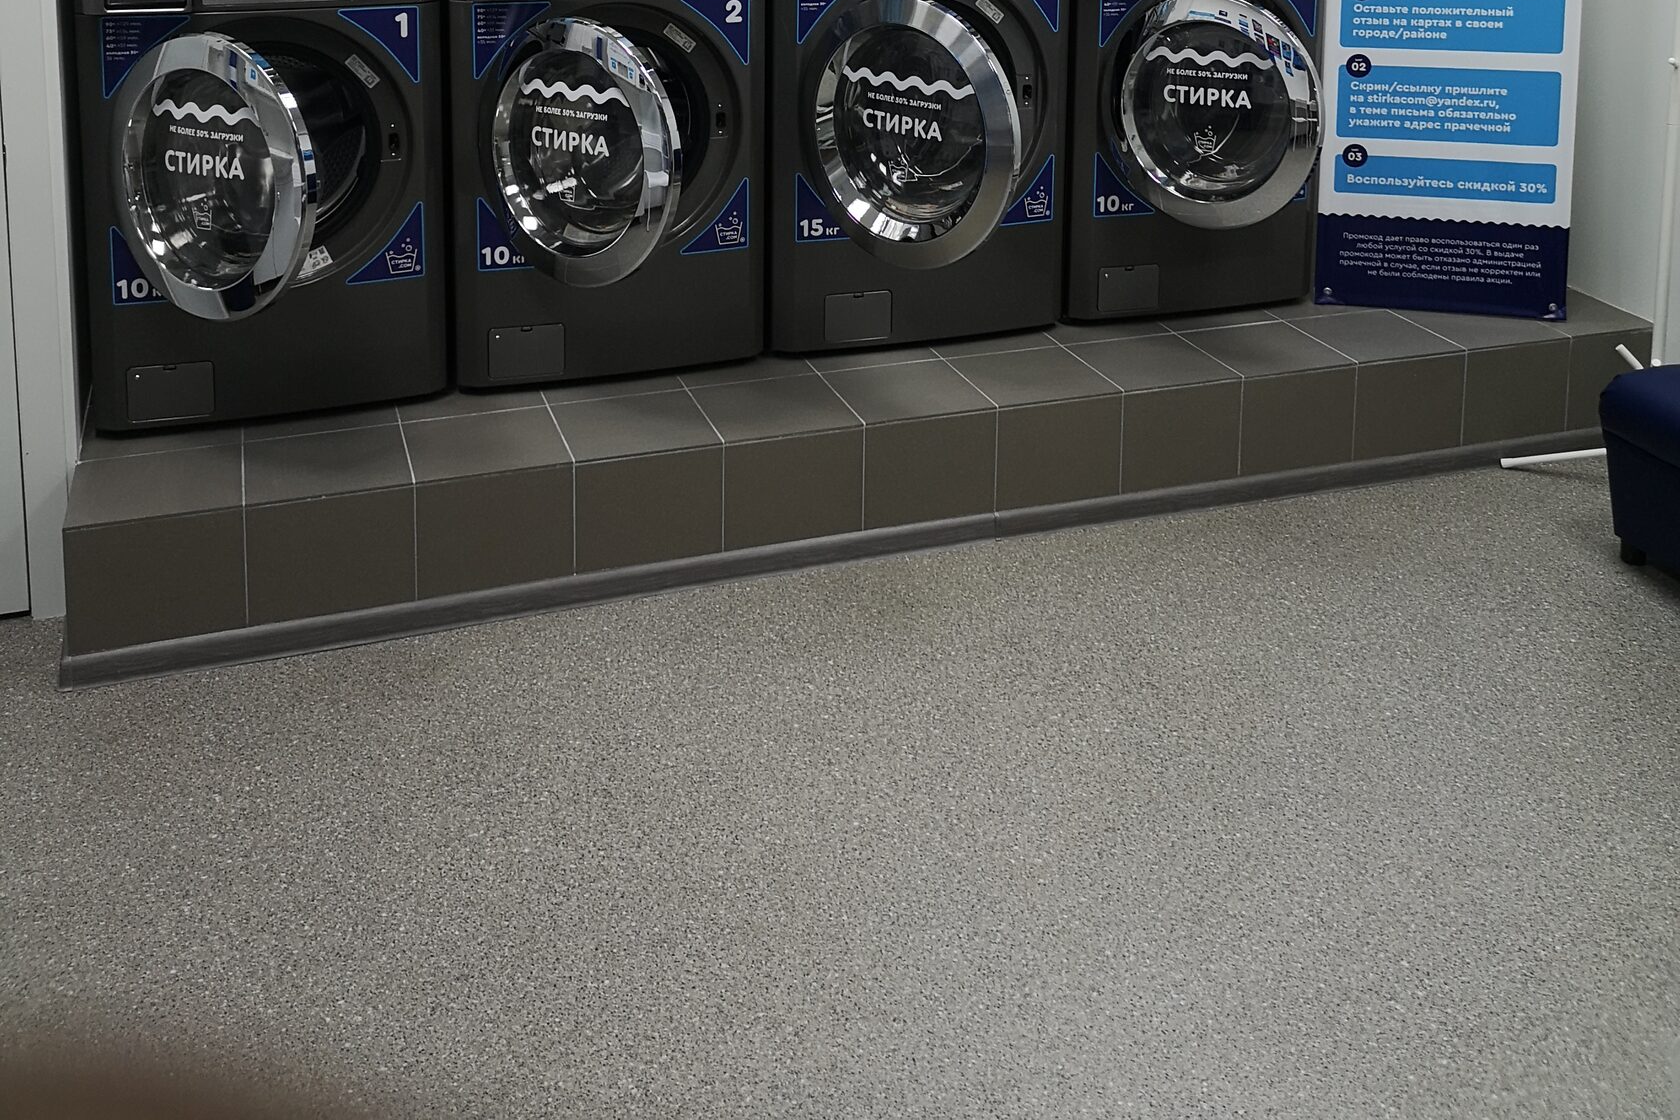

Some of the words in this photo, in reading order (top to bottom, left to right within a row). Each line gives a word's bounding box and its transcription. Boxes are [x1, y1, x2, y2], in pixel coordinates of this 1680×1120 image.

[725, 0, 742, 23] 2
[1354, 4, 1408, 14] Оставьте
[1412, 6, 1514, 17] положительный
[394, 12, 408, 38] 1
[1353, 17, 1389, 26] отзыв
[1393, 18, 1407, 26] на
[1410, 19, 1451, 29] картах
[1466, 21, 1503, 29] своем
[1352, 28, 1447, 40] городе/районе
[1213, 71, 1248, 80] ЗАГРУЗКИ
[1351, 62, 1366, 72] 02
[1163, 84, 1251, 109] СТИРКА
[1350, 81, 1441, 94] Скрин/ссылку
[1445, 86, 1508, 96] пришлите
[876, 93, 894, 103] БОЛЕЕ
[895, 96, 908, 105] 50%
[909, 99, 942, 110] ЗАГРУЗКИ
[1350, 95, 1364, 103] на
[1367, 94, 1500, 110] stirkacom@yandex.ru,
[544, 107, 561, 116] БОЛЕЕ
[562, 109, 575, 117] 50%
[576, 111, 608, 122] ЗАГРУЗКИ
[1391, 108, 1435, 118] письма
[1438, 109, 1516, 120] обязательно
[169, 125, 176, 133] НЕ
[177, 126, 196, 137] БОЛЕЕ
[196, 129, 209, 138] 50%
[210, 131, 244, 142] ЗАГРУЗКИ
[862, 108, 942, 142] СТИРКА
[1349, 118, 1400, 129] укажите
[1404, 121, 1441, 131] адрес
[1444, 121, 1511, 133] прачечной
[531, 126, 609, 157] СТИРКА
[164, 150, 245, 180] СТИРКА
[1348, 152, 1362, 161] 03
[1347, 174, 1454, 189] Воспользуйтесь
[1458, 180, 1516, 192] скидкой
[1519, 183, 1548, 194] 30%
[1096, 195, 1119, 213] 10
[1122, 202, 1134, 211] КГ
[800, 218, 823, 237] 15
[826, 227, 840, 236] КГ
[1343, 232, 1383, 242] Промокод
[1385, 235, 1403, 243] дает
[1405, 236, 1429, 245] право
[1431, 238, 1500, 248] воспользоваться
[1502, 242, 1522, 250] один
[1525, 243, 1539, 251] раз
[1356, 242, 1383, 250] любой
[1385, 243, 1416, 252] услугой
[1430, 246, 1464, 255] скидкой
[1465, 248, 1484, 256] 30%.
[481, 246, 510, 266] 10
[1339, 250, 1383, 258] промокода
[1412, 253, 1432, 262] быть
[1434, 256, 1471, 264] отказано
[1472, 258, 1542, 269] администрацией
[1339, 259, 1382, 268] прачечной
[1390, 263, 1419, 271] случае,
[1481, 268, 1523, 277] корректен
[1379, 268, 1400, 277] были
[1402, 271, 1449, 281] соблюдены
[1451, 274, 1485, 283] правила
[1487, 277, 1512, 285] акции.
[116, 278, 148, 299] 10
